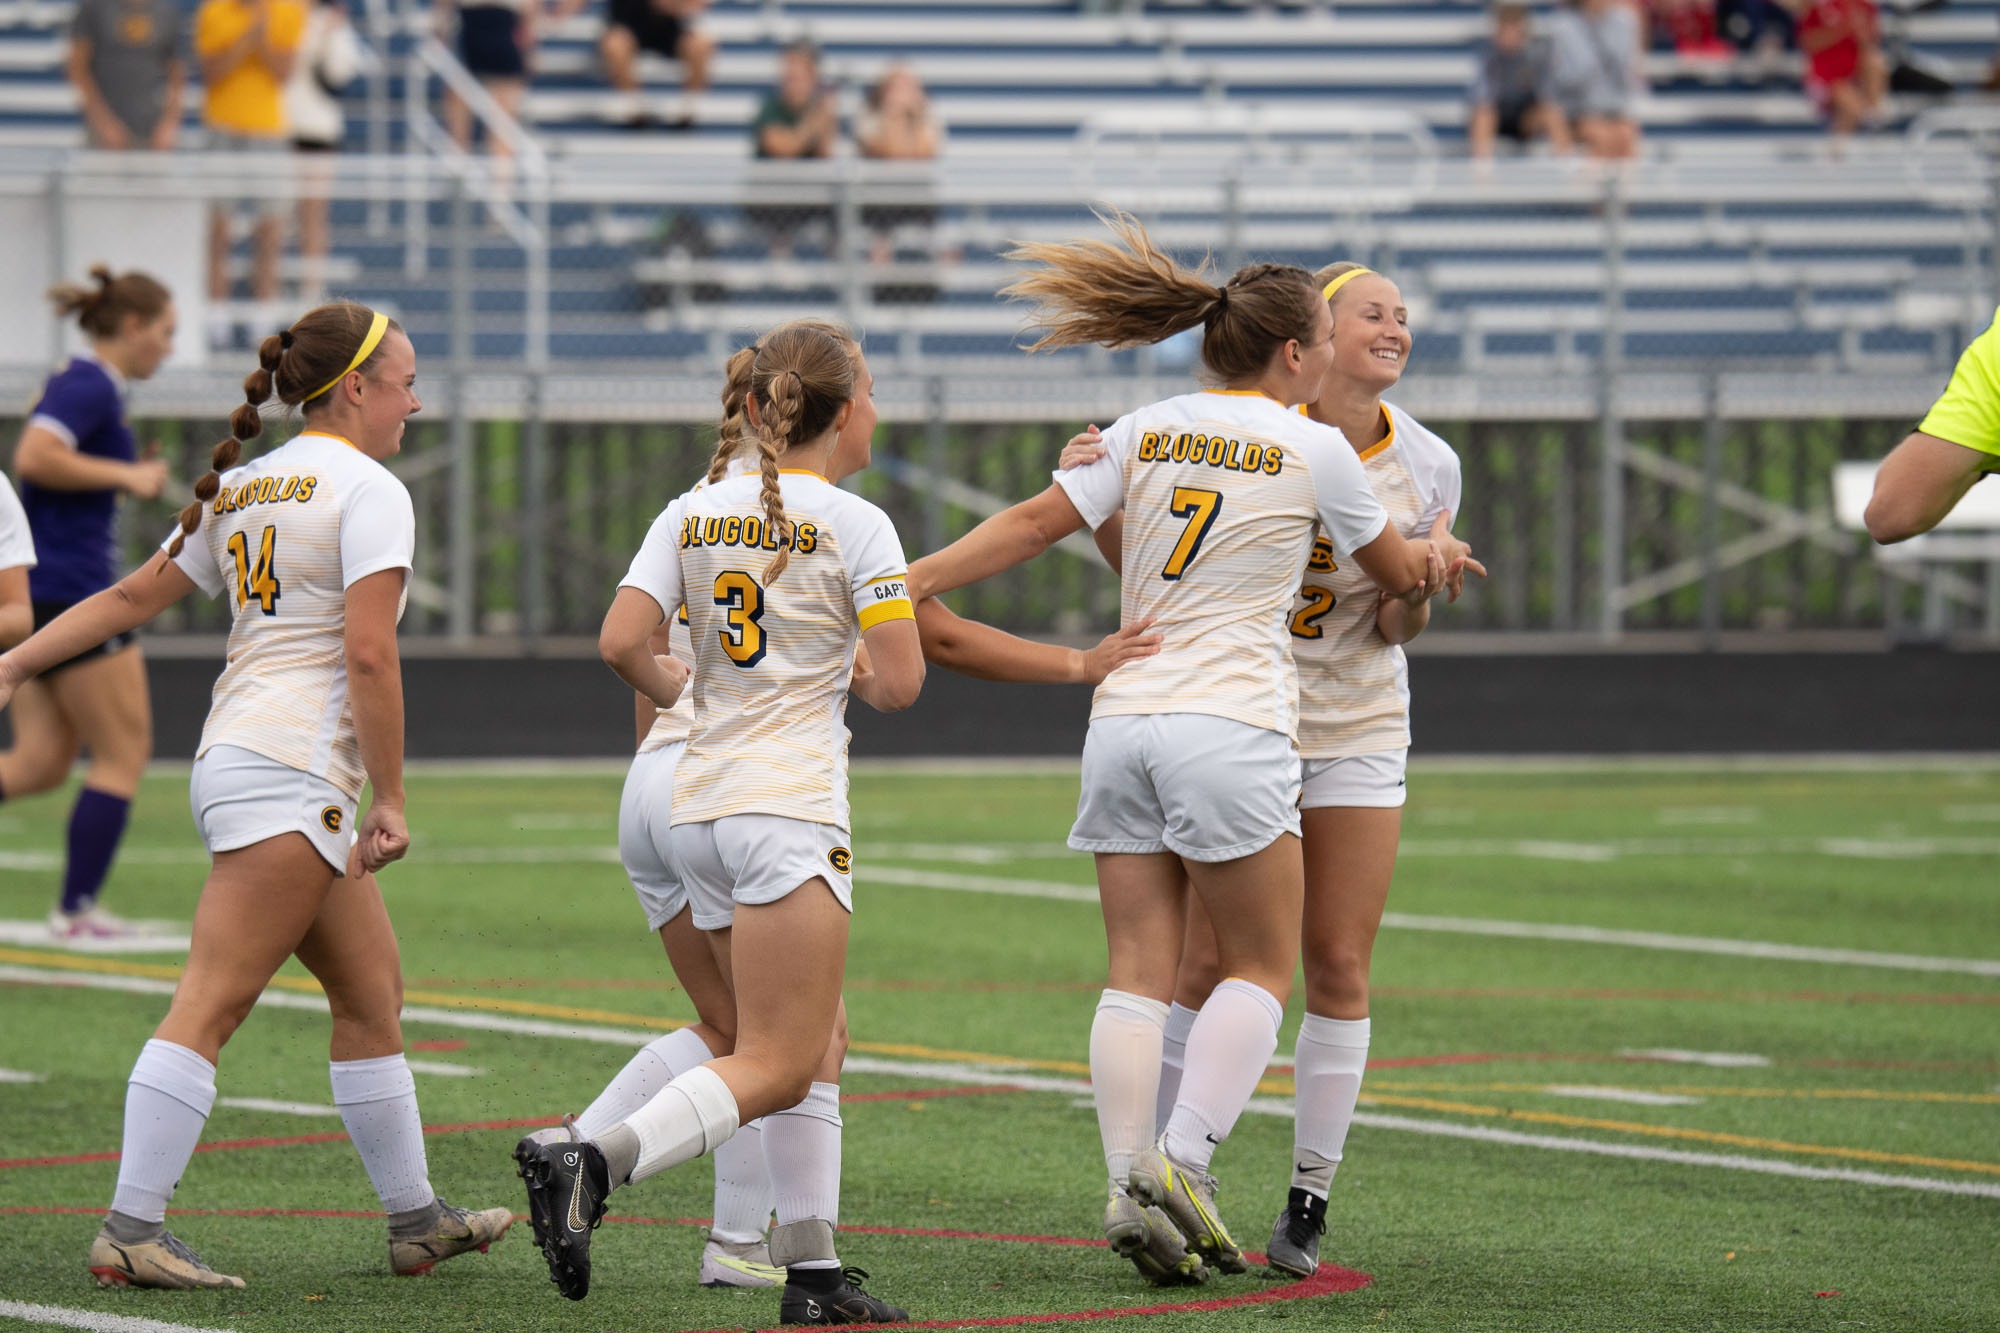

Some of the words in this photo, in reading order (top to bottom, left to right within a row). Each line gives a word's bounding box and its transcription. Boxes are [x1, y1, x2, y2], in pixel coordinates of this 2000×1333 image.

[1138, 432, 1283, 476] BLUGOLDS
[214, 476, 317, 515] BLUGOLDS
[1161, 486, 1223, 581] 7
[228, 525, 281, 616] 14
[874, 583, 909, 599] CAPT
[714, 570, 767, 668] 3
[1285, 585, 1337, 639] 2
